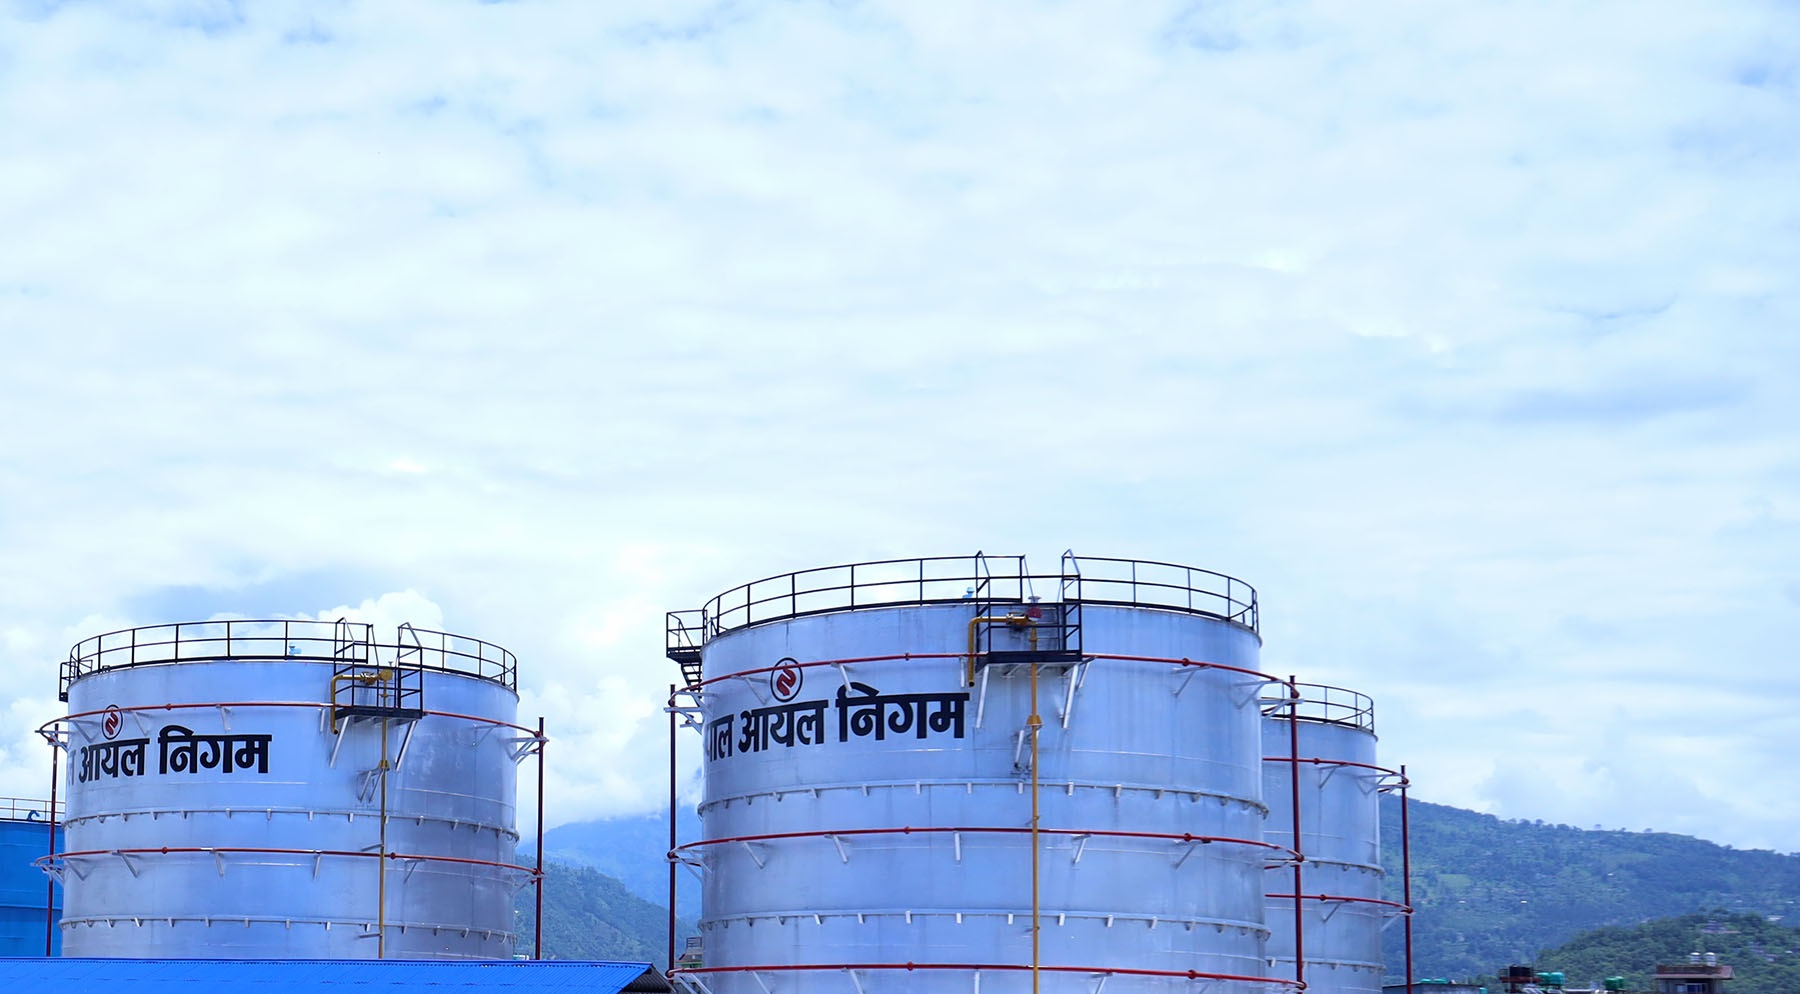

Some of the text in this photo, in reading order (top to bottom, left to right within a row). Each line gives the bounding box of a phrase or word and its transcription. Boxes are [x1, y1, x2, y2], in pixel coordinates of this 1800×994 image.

[738, 700, 828, 753] आयल
[835, 682, 970, 742] निगम
[79, 738, 150, 783] आयल
[157, 725, 272, 774] निगम
